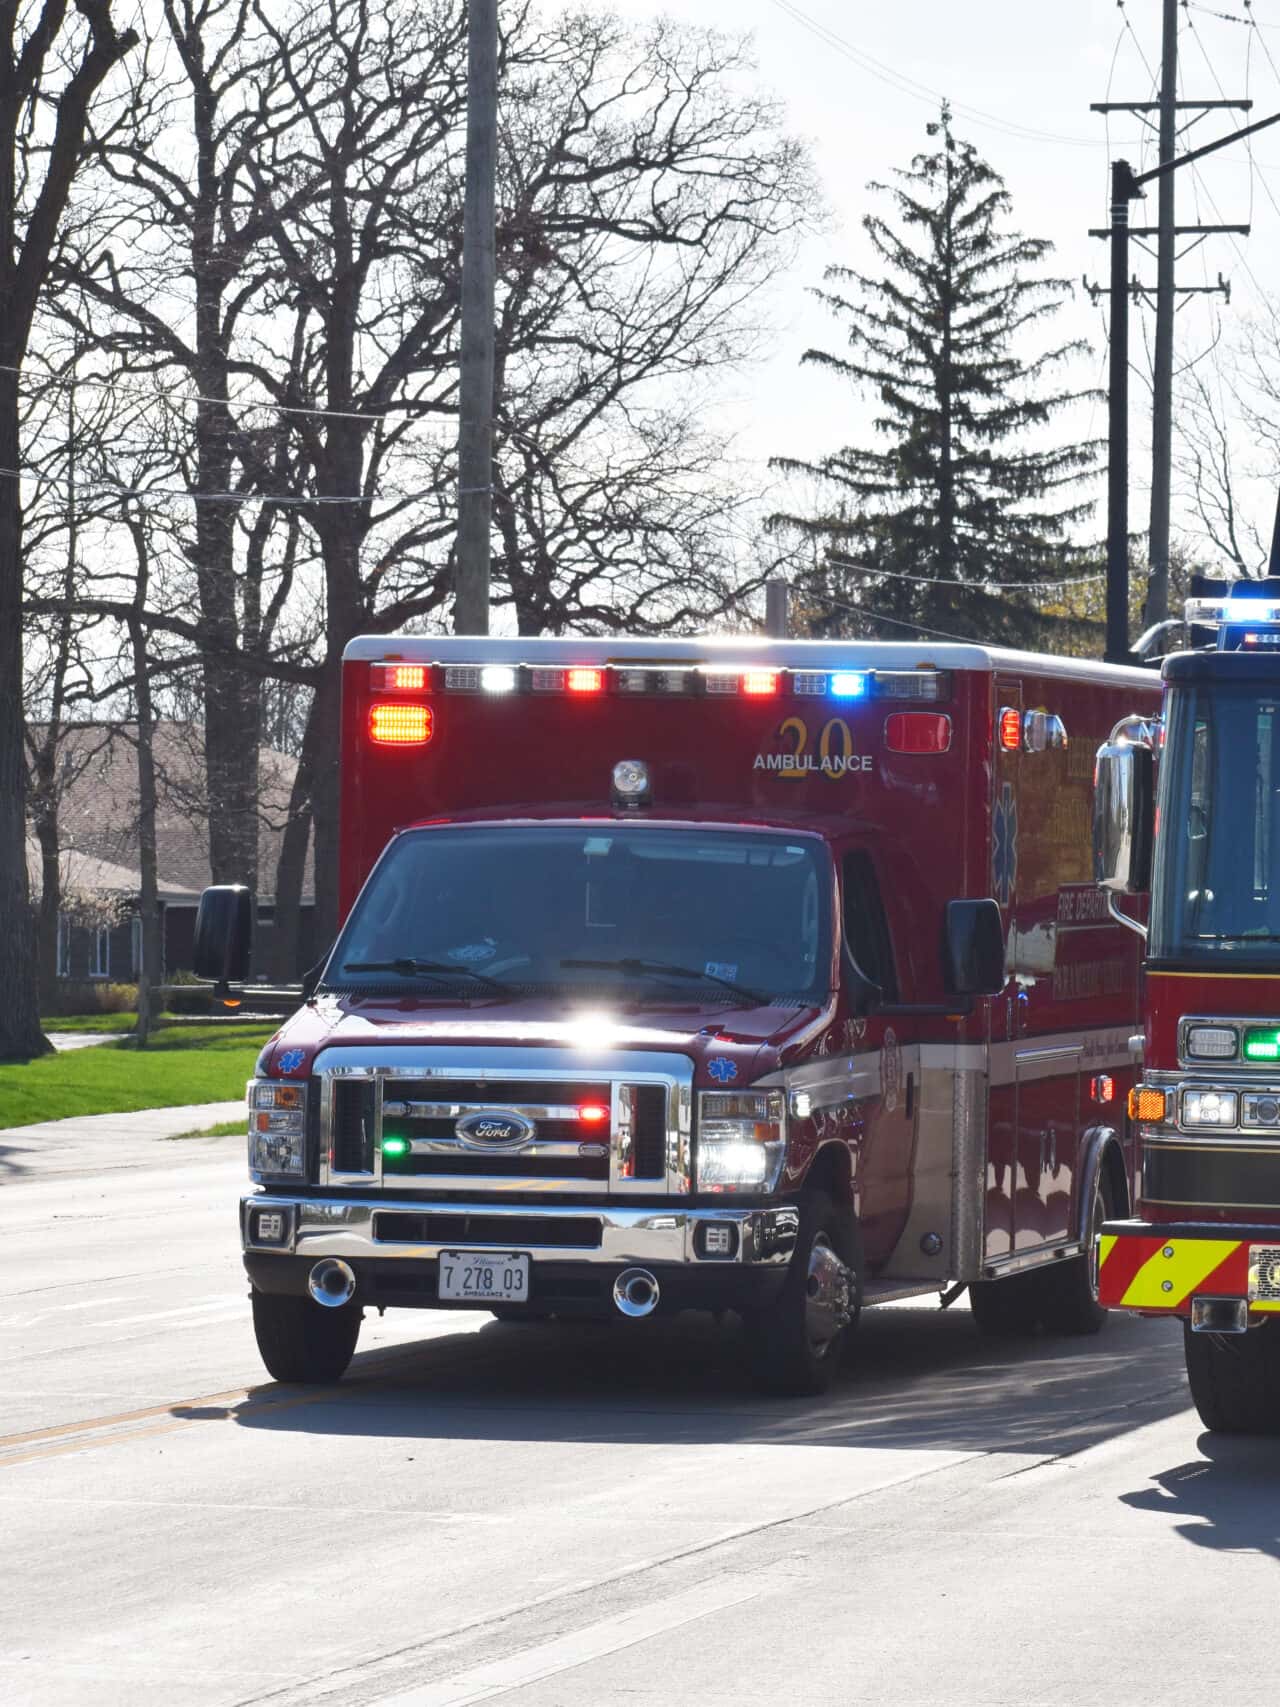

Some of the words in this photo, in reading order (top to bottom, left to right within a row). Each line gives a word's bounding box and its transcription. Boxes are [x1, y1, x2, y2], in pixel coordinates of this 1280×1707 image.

[778, 716, 853, 779] 20
[753, 753, 873, 771] AMBULANCE
[475, 1121, 511, 1138] Ford
[444, 1266, 454, 1289] 7
[463, 1267, 494, 1290] 278
[504, 1268, 524, 1290] 03
